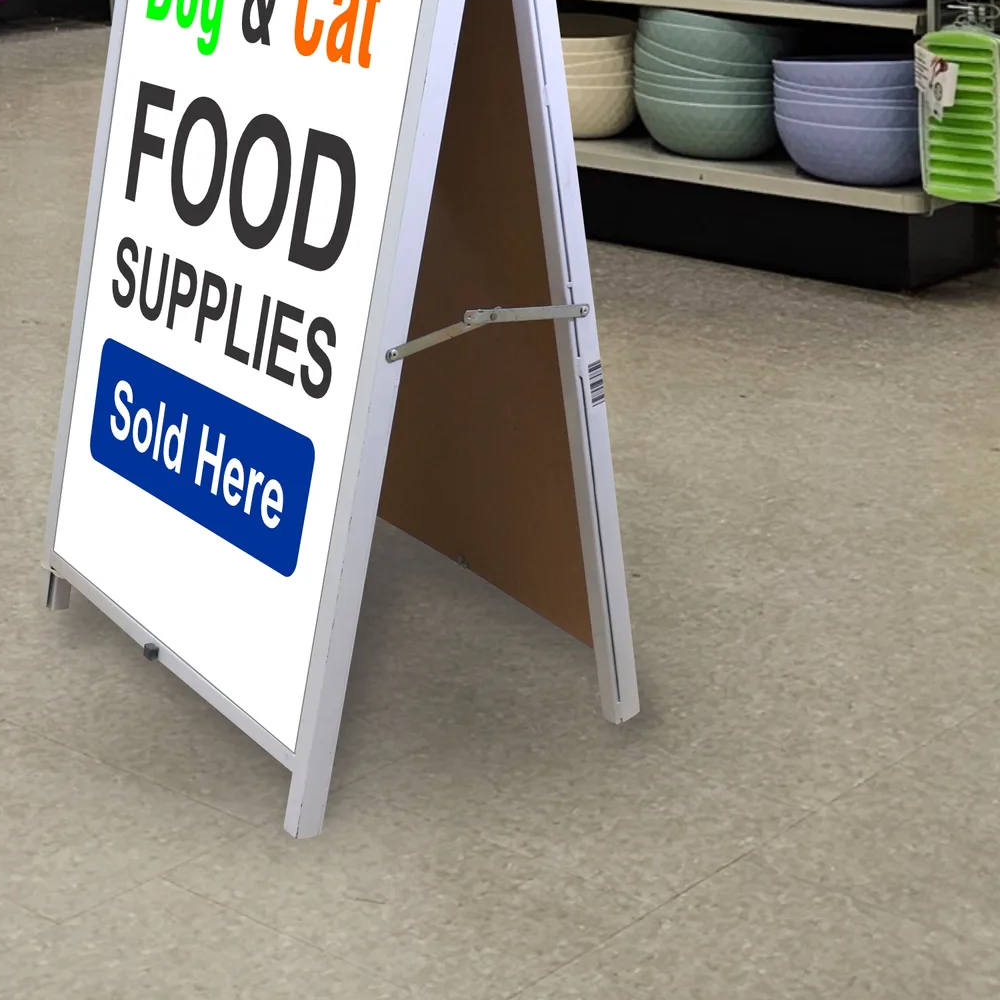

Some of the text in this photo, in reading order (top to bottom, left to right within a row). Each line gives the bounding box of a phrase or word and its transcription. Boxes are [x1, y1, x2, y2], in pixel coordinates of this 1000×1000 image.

[125, 81, 355, 271] FOOD
[113, 237, 337, 398] SUPPLIES
[111, 381, 284, 528] Sold Here
